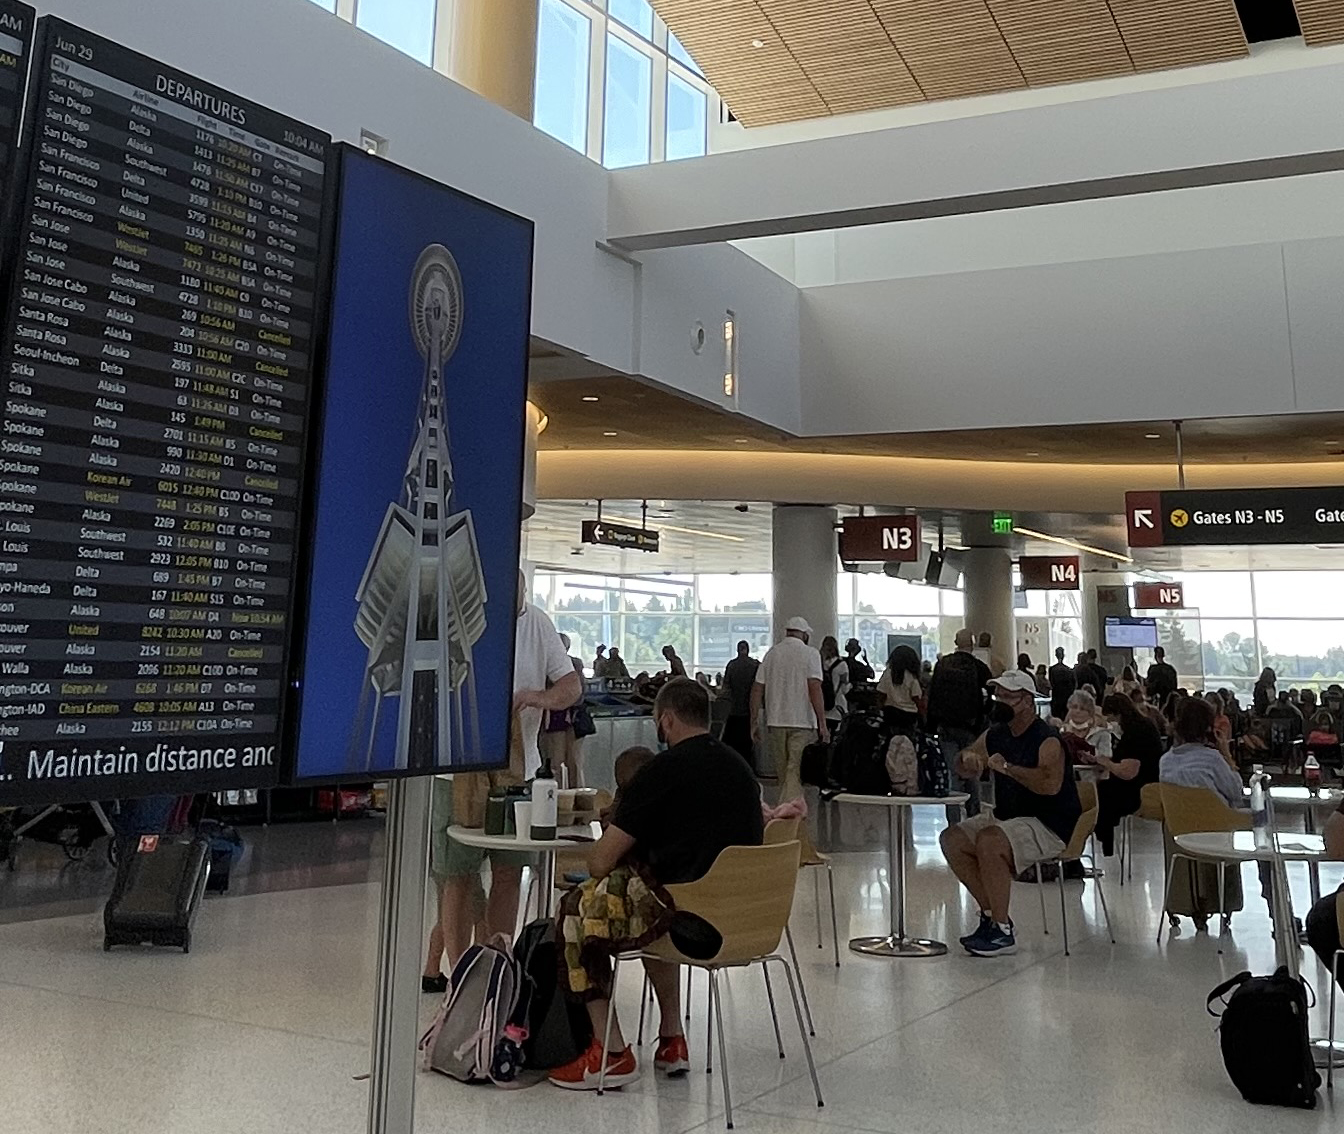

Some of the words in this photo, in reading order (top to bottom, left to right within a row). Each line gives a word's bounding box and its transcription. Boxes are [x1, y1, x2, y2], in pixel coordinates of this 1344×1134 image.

[0, 13, 22, 31] AM
[1192, 510, 1232, 525] Gates
[1235, 510, 1254, 524] N3
[1265, 509, 1285, 523] N5
[993, 518, 1012, 533] EXIT
[882, 527, 912, 550] N3
[1051, 565, 1076, 582] N4
[1159, 589, 1181, 603] N5
[1025, 623, 1040, 634] N5
